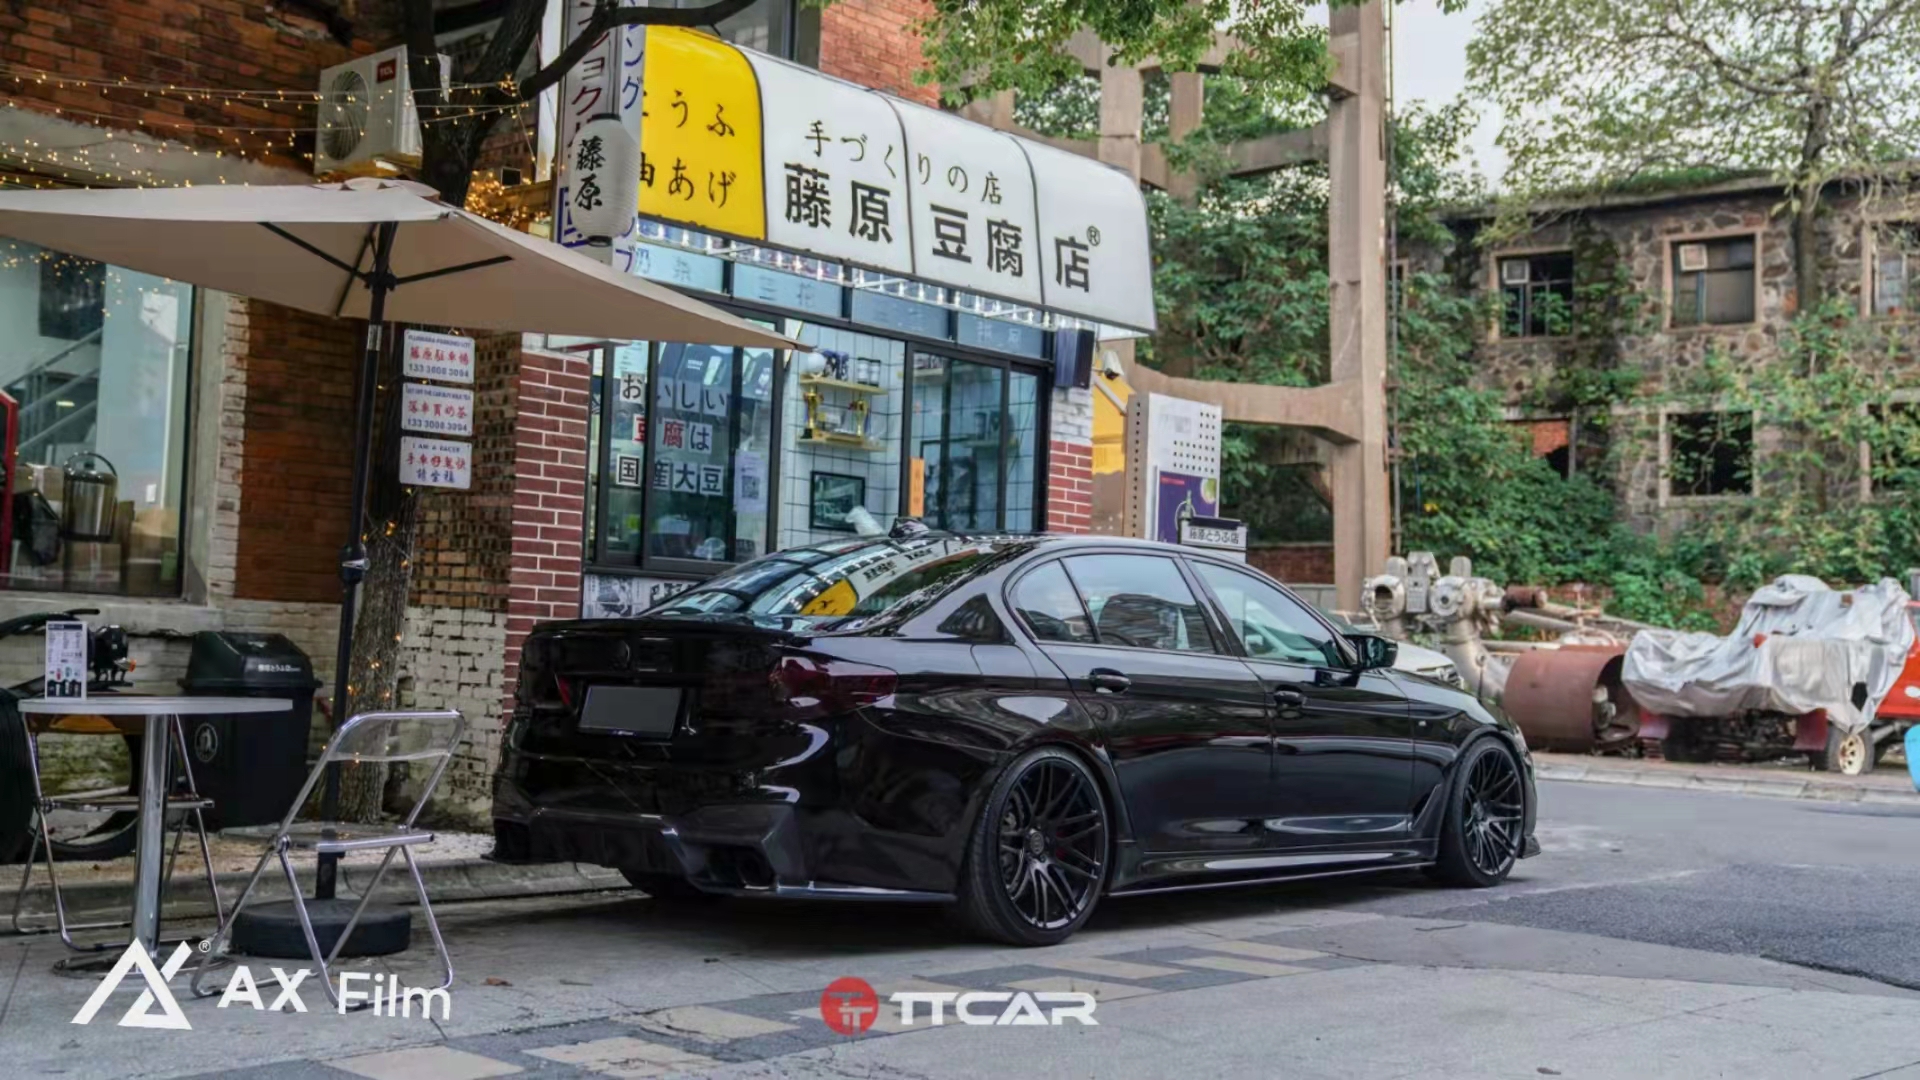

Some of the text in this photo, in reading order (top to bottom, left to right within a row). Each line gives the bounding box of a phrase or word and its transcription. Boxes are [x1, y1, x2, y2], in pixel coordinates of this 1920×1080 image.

[642, 88, 736, 137] うふ
[575, 135, 606, 211] 藤原
[805, 119, 1003, 206] 手づくりの店
